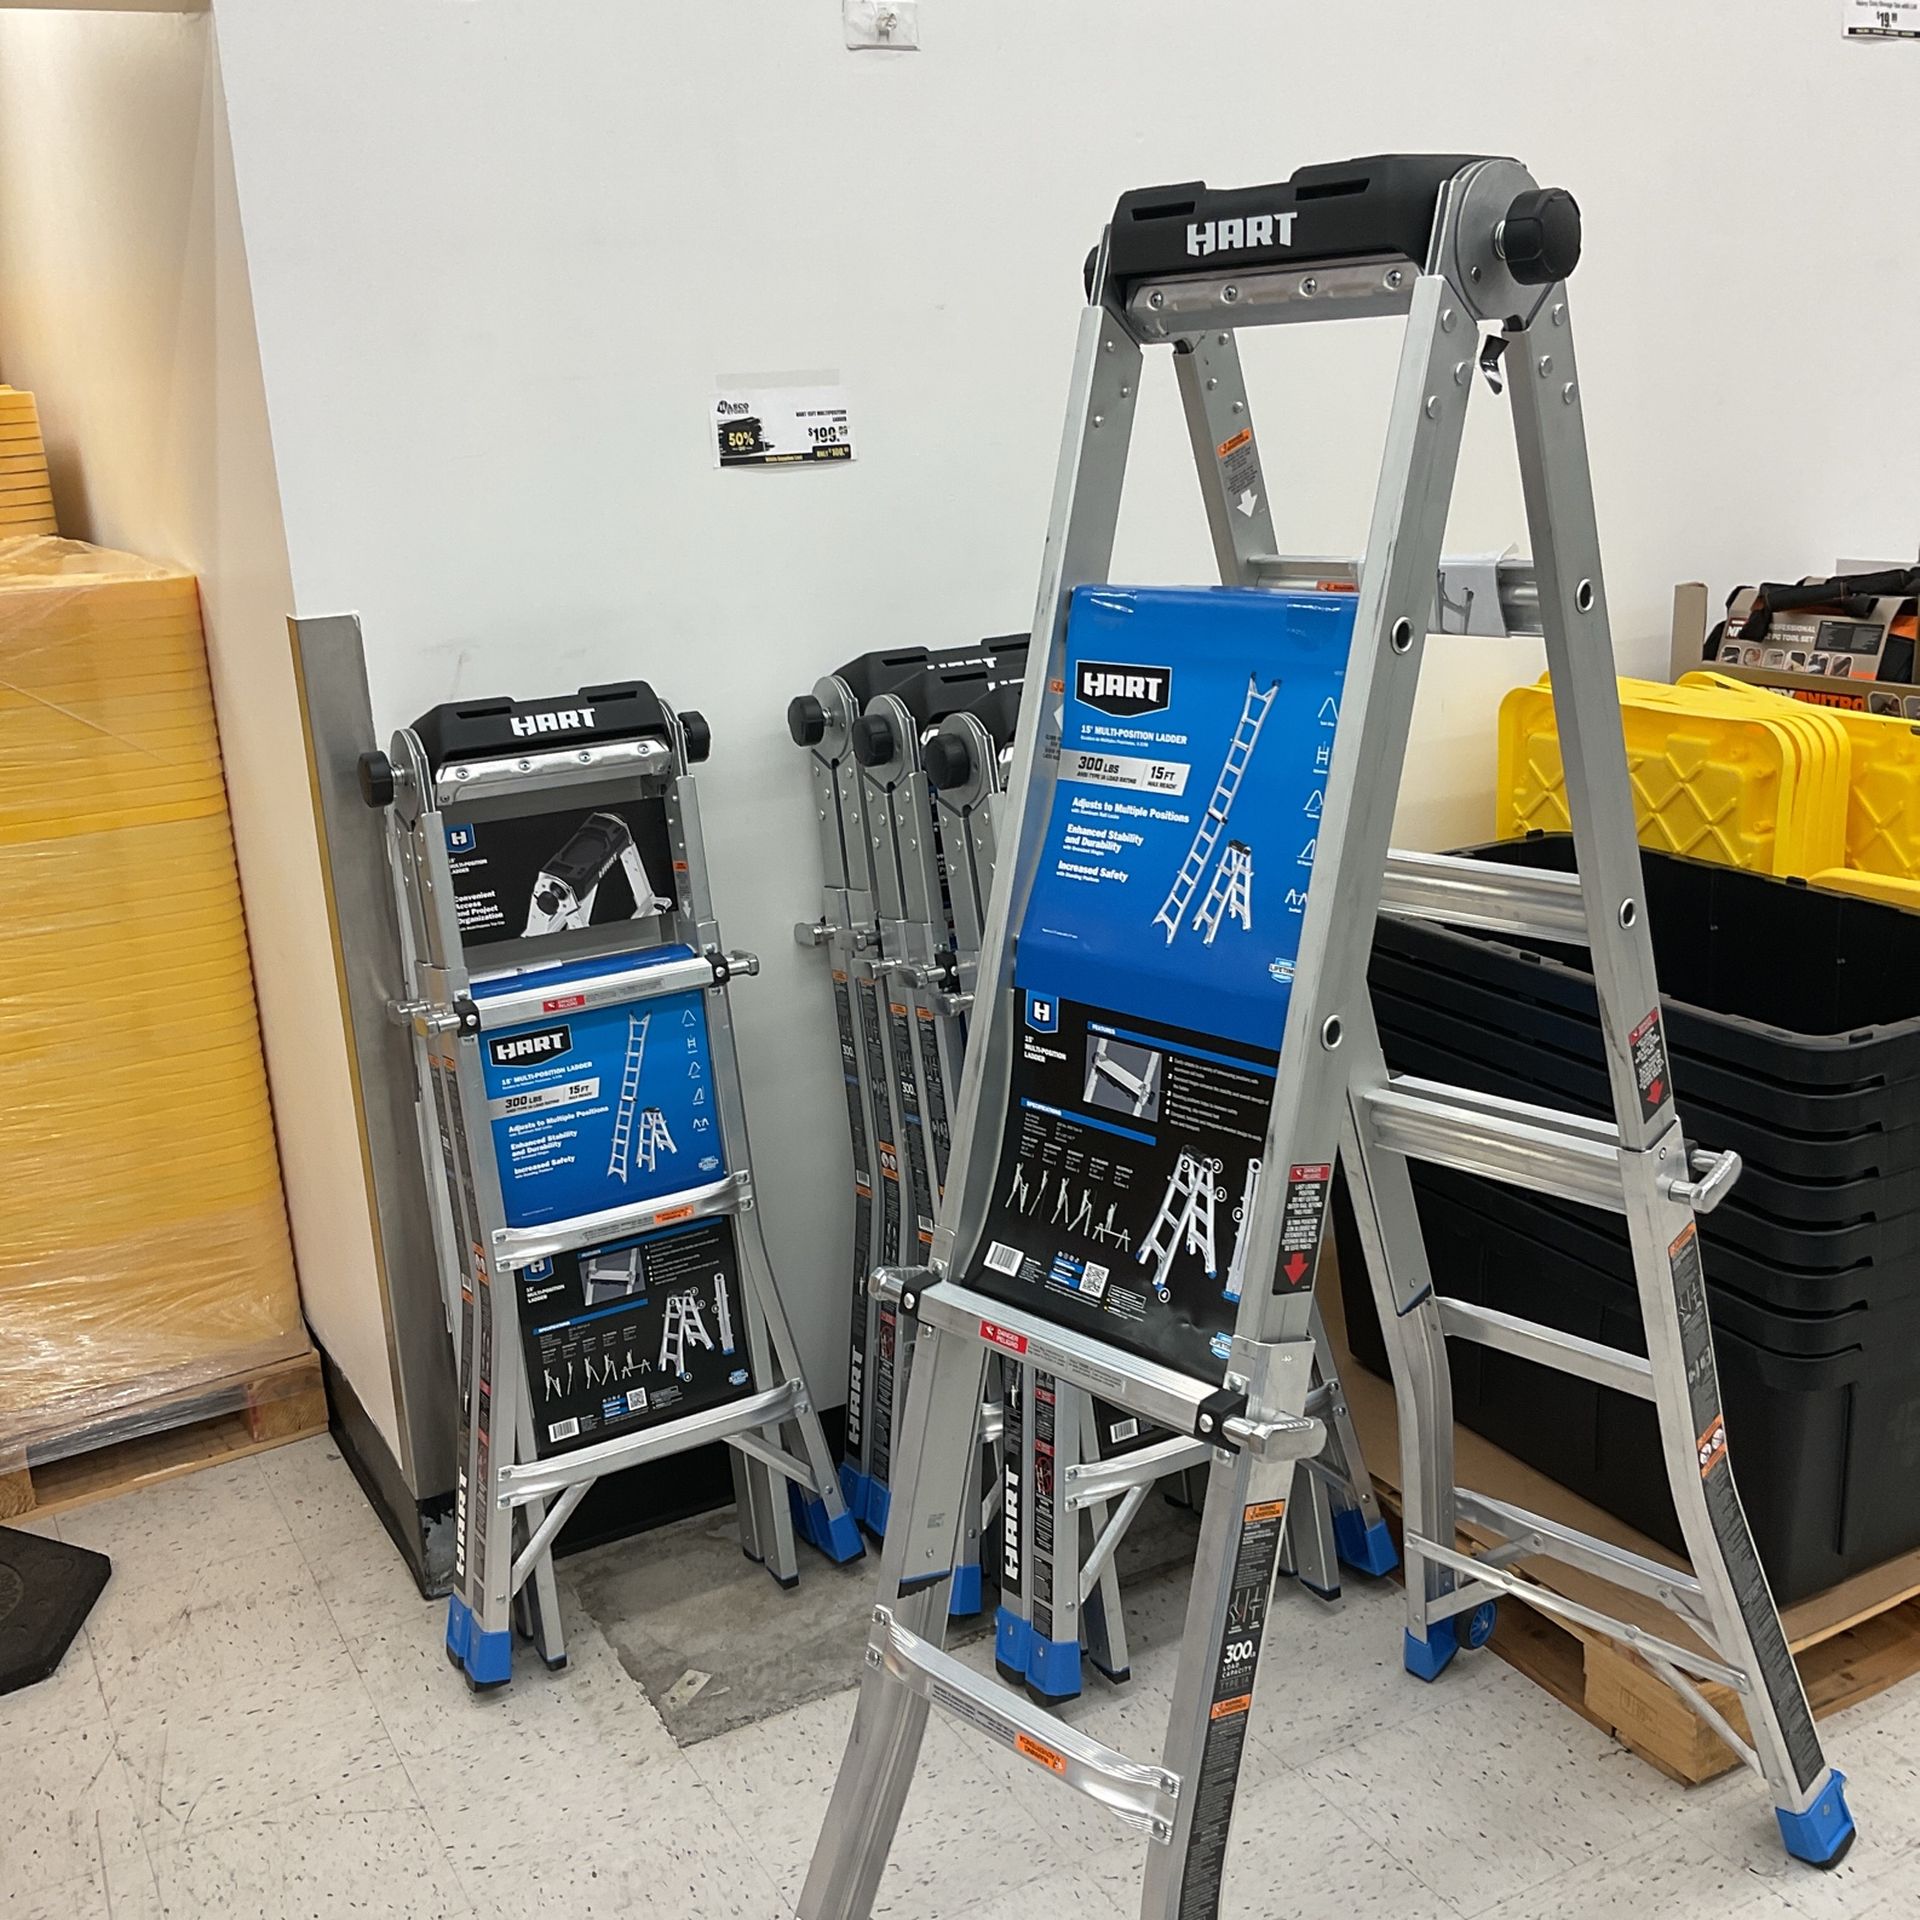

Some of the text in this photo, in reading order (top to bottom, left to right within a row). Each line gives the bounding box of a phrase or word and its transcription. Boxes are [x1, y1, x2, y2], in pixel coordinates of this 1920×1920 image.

[1186, 211, 1299, 257] HART
[728, 431, 755, 447] 50%
[1083, 671, 1162, 702] HART
[510, 708, 595, 737] HART
[1094, 725, 1155, 741] MULTI-POSITION
[1155, 732, 1188, 744] LADDER
[1078, 756, 1120, 774] 300 LBS
[1151, 765, 1176, 781] 15 FT
[1072, 797, 1190, 823] Adjusts to Multiple Positions
[451, 831, 468, 845] H
[1064, 835, 1122, 854] and Durability
[1067, 823, 1144, 846] Enhanced Stability
[1057, 860, 1129, 883] Increased Safety
[471, 904, 499, 915] Project
[1270, 963, 1295, 977] LIFETIM
[1033, 1001, 1051, 1021] H
[496, 1032, 564, 1060] HART
[566, 1061, 593, 1072] LADDER
[569, 1085, 589, 1095] 15 FT
[505, 1095, 543, 1108] 300 LBS
[508, 1122, 536, 1134] Adjusts
[536, 1119, 545, 1127] to
[546, 1113, 575, 1124] Multiple
[575, 1106, 609, 1118] Positions
[510, 1137, 546, 1150] Enhanced
[547, 1130, 578, 1141] Stability
[511, 1149, 526, 1157] and
[526, 1141, 562, 1154] Durability
[514, 1160, 550, 1175] Increased
[551, 1155, 576, 1166] Safety
[849, 1345, 863, 1445] HART
[456, 1466, 467, 1576] HART
[1004, 1464, 1019, 1580] HART
[1224, 1640, 1253, 1664] 300
[1222, 1663, 1240, 1672] LOAD
[1222, 1665, 1252, 1678] CAPACITY
